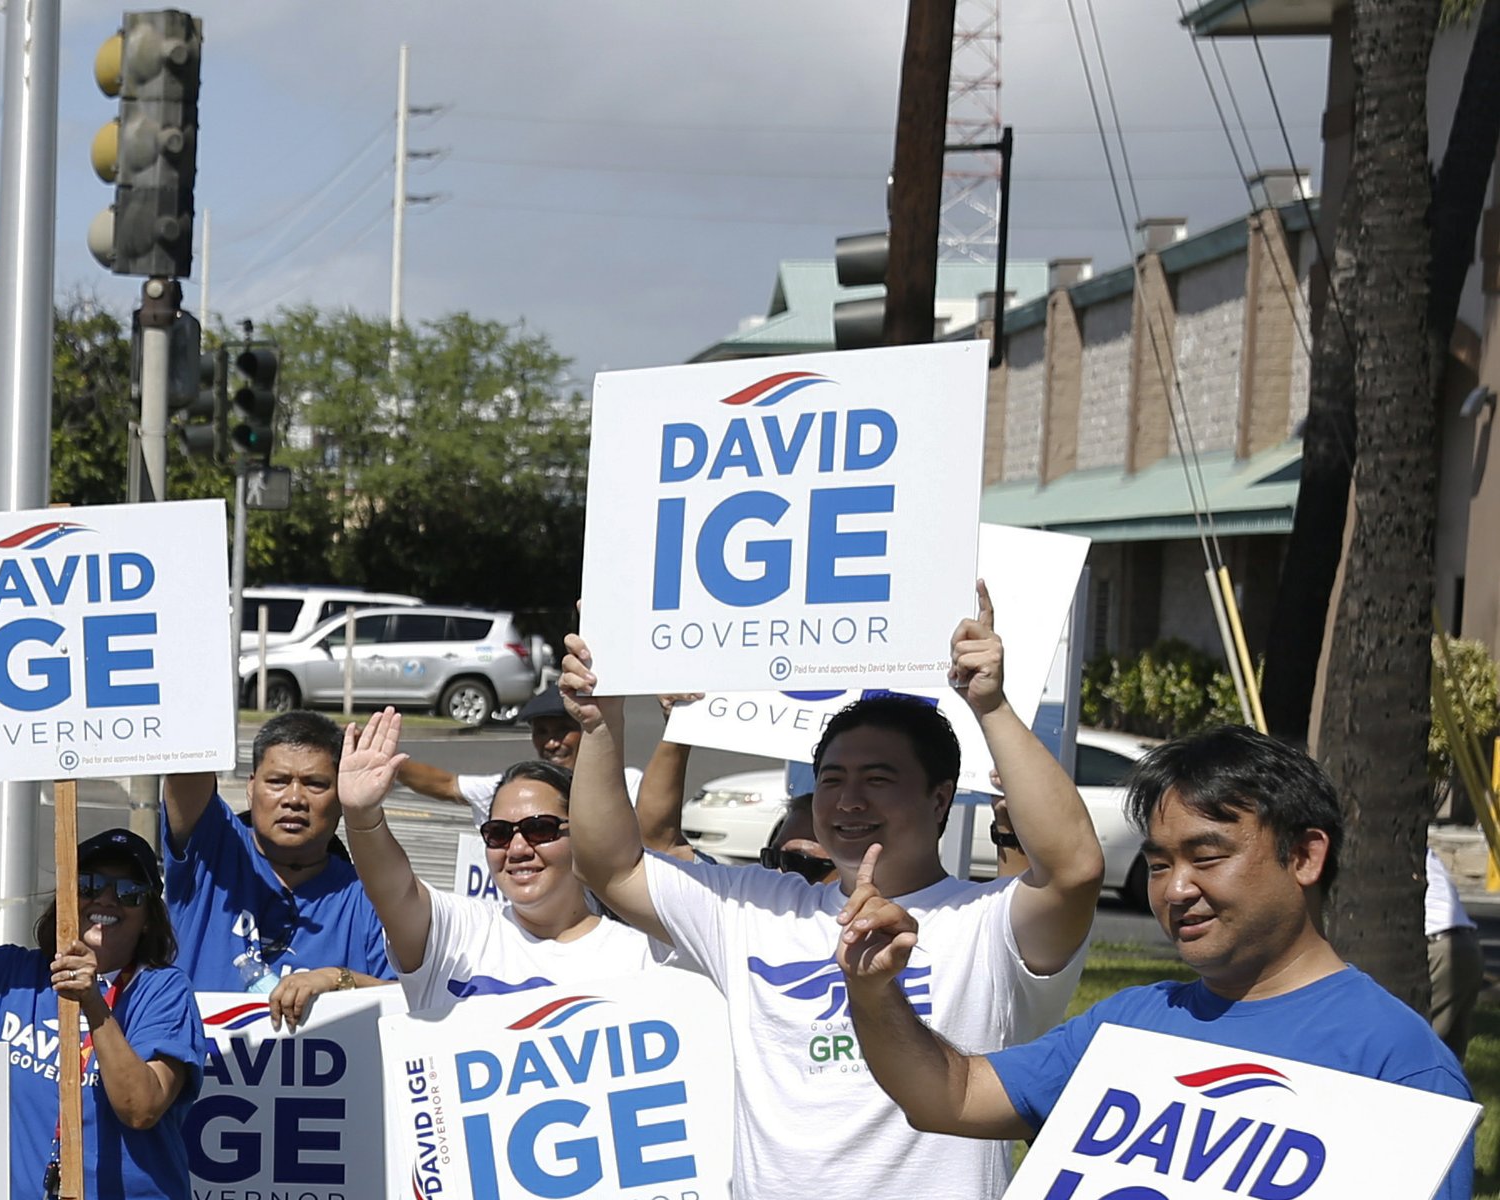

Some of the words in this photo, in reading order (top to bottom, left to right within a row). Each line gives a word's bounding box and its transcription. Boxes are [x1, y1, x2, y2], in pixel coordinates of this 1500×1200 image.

[659, 408, 898, 483] DAVID
[652, 484, 895, 611] IGE
[651, 616, 890, 650] GOVERNOR
[794, 665, 807, 673] Paid
[808, 665, 816, 673] for
[818, 665, 829, 673] and
[831, 664, 858, 674] approved
[860, 664, 867, 673] by
[868, 664, 885, 672] David
[887, 663, 896, 672] Ige
[897, 663, 906, 671] for
[908, 662, 934, 671] Governor
[139, 755, 145, 763] by
[180, 752, 204, 760] Governor
[202, 1037, 347, 1087] AVID
[405, 1058, 429, 1104] IGE
[455, 1020, 680, 1104] DAVID
[187, 1094, 346, 1185] GE
[414, 1112, 443, 1194] DAVID
[431, 1086, 450, 1165] GOVERNOR
